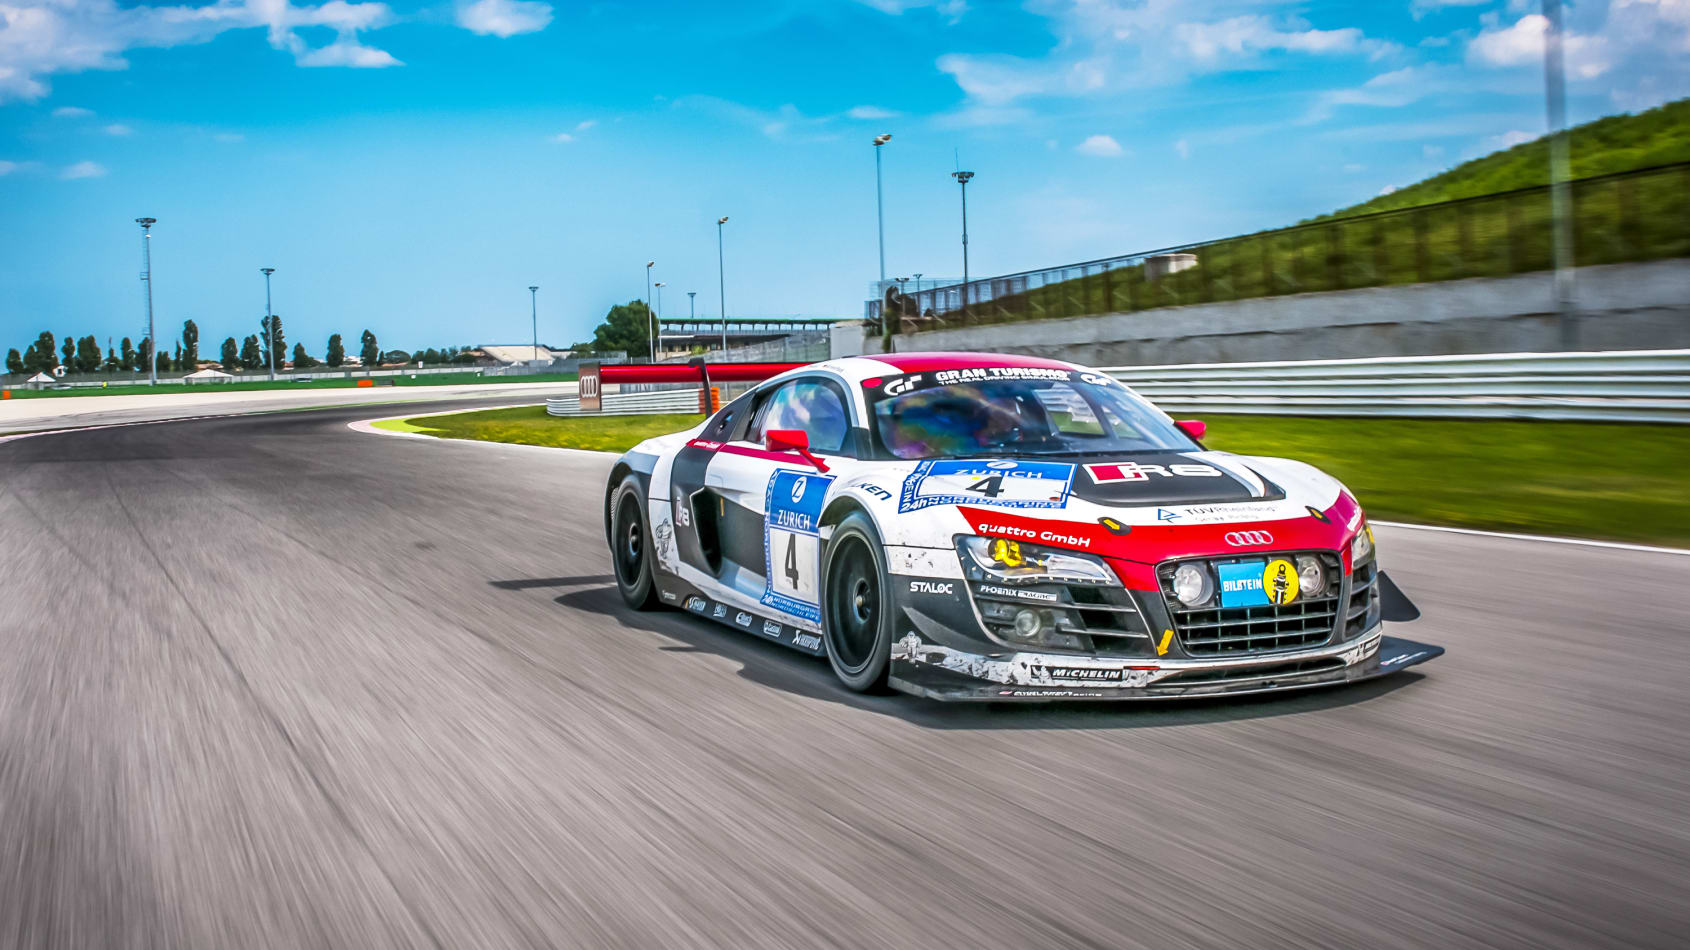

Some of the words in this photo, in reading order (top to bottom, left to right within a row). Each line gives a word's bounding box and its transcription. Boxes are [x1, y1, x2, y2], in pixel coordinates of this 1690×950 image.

[935, 368, 987, 381] GRAN
[989, 367, 1068, 378] TURISMO
[953, 468, 1043, 479] ZURICH
[857, 482, 893, 501] KEN
[965, 476, 1005, 498] 4
[777, 509, 811, 529] ZURICH
[978, 523, 1037, 538] quattro
[1040, 532, 1090, 548] GmbH
[784, 533, 799, 591] 4
[910, 581, 953, 594] STALOC
[1223, 578, 1262, 592] BILSTEIN
[1052, 668, 1121, 679] MICHELIN
